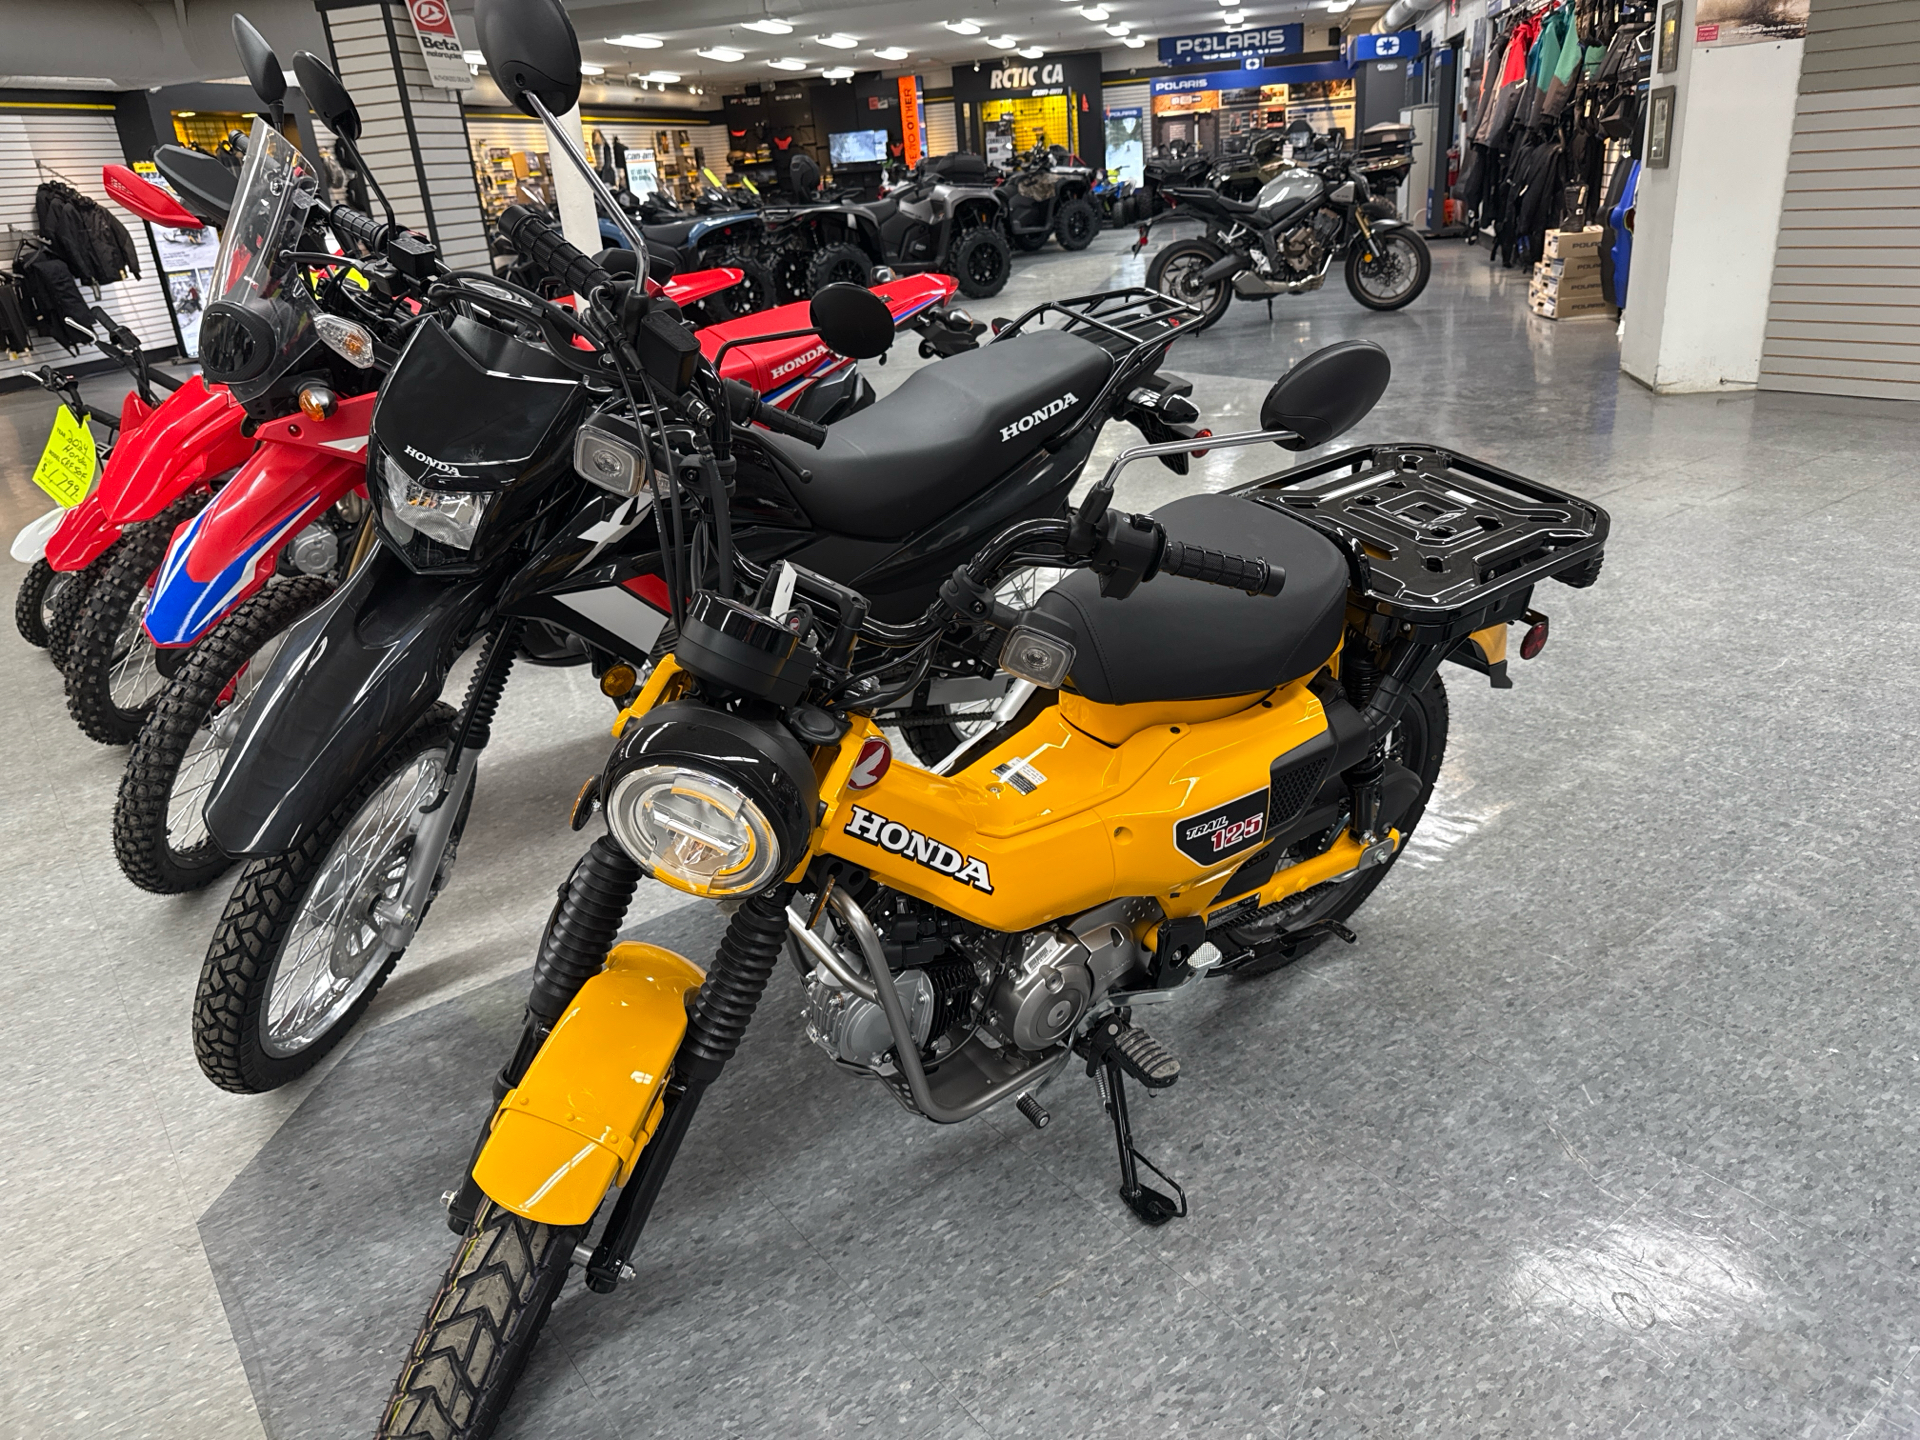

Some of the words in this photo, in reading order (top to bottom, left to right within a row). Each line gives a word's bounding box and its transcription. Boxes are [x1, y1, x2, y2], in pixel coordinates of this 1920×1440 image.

[420, 36, 460, 51] Beta
[426, 50, 464, 60] motorcycles
[1176, 29, 1285, 55] POLARIS
[990, 65, 1038, 89] RCTIC
[1042, 63, 1064, 84] CA
[1155, 78, 1208, 91] POLARIS
[1571, 302, 1606, 310] POLARIS
[771, 344, 829, 380] HONDA
[999, 392, 1079, 442] HONDA
[403, 444, 461, 477] HONDA
[1186, 815, 1229, 840] TRAIL
[1211, 812, 1264, 852] 125
[843, 804, 995, 895] HONDA
